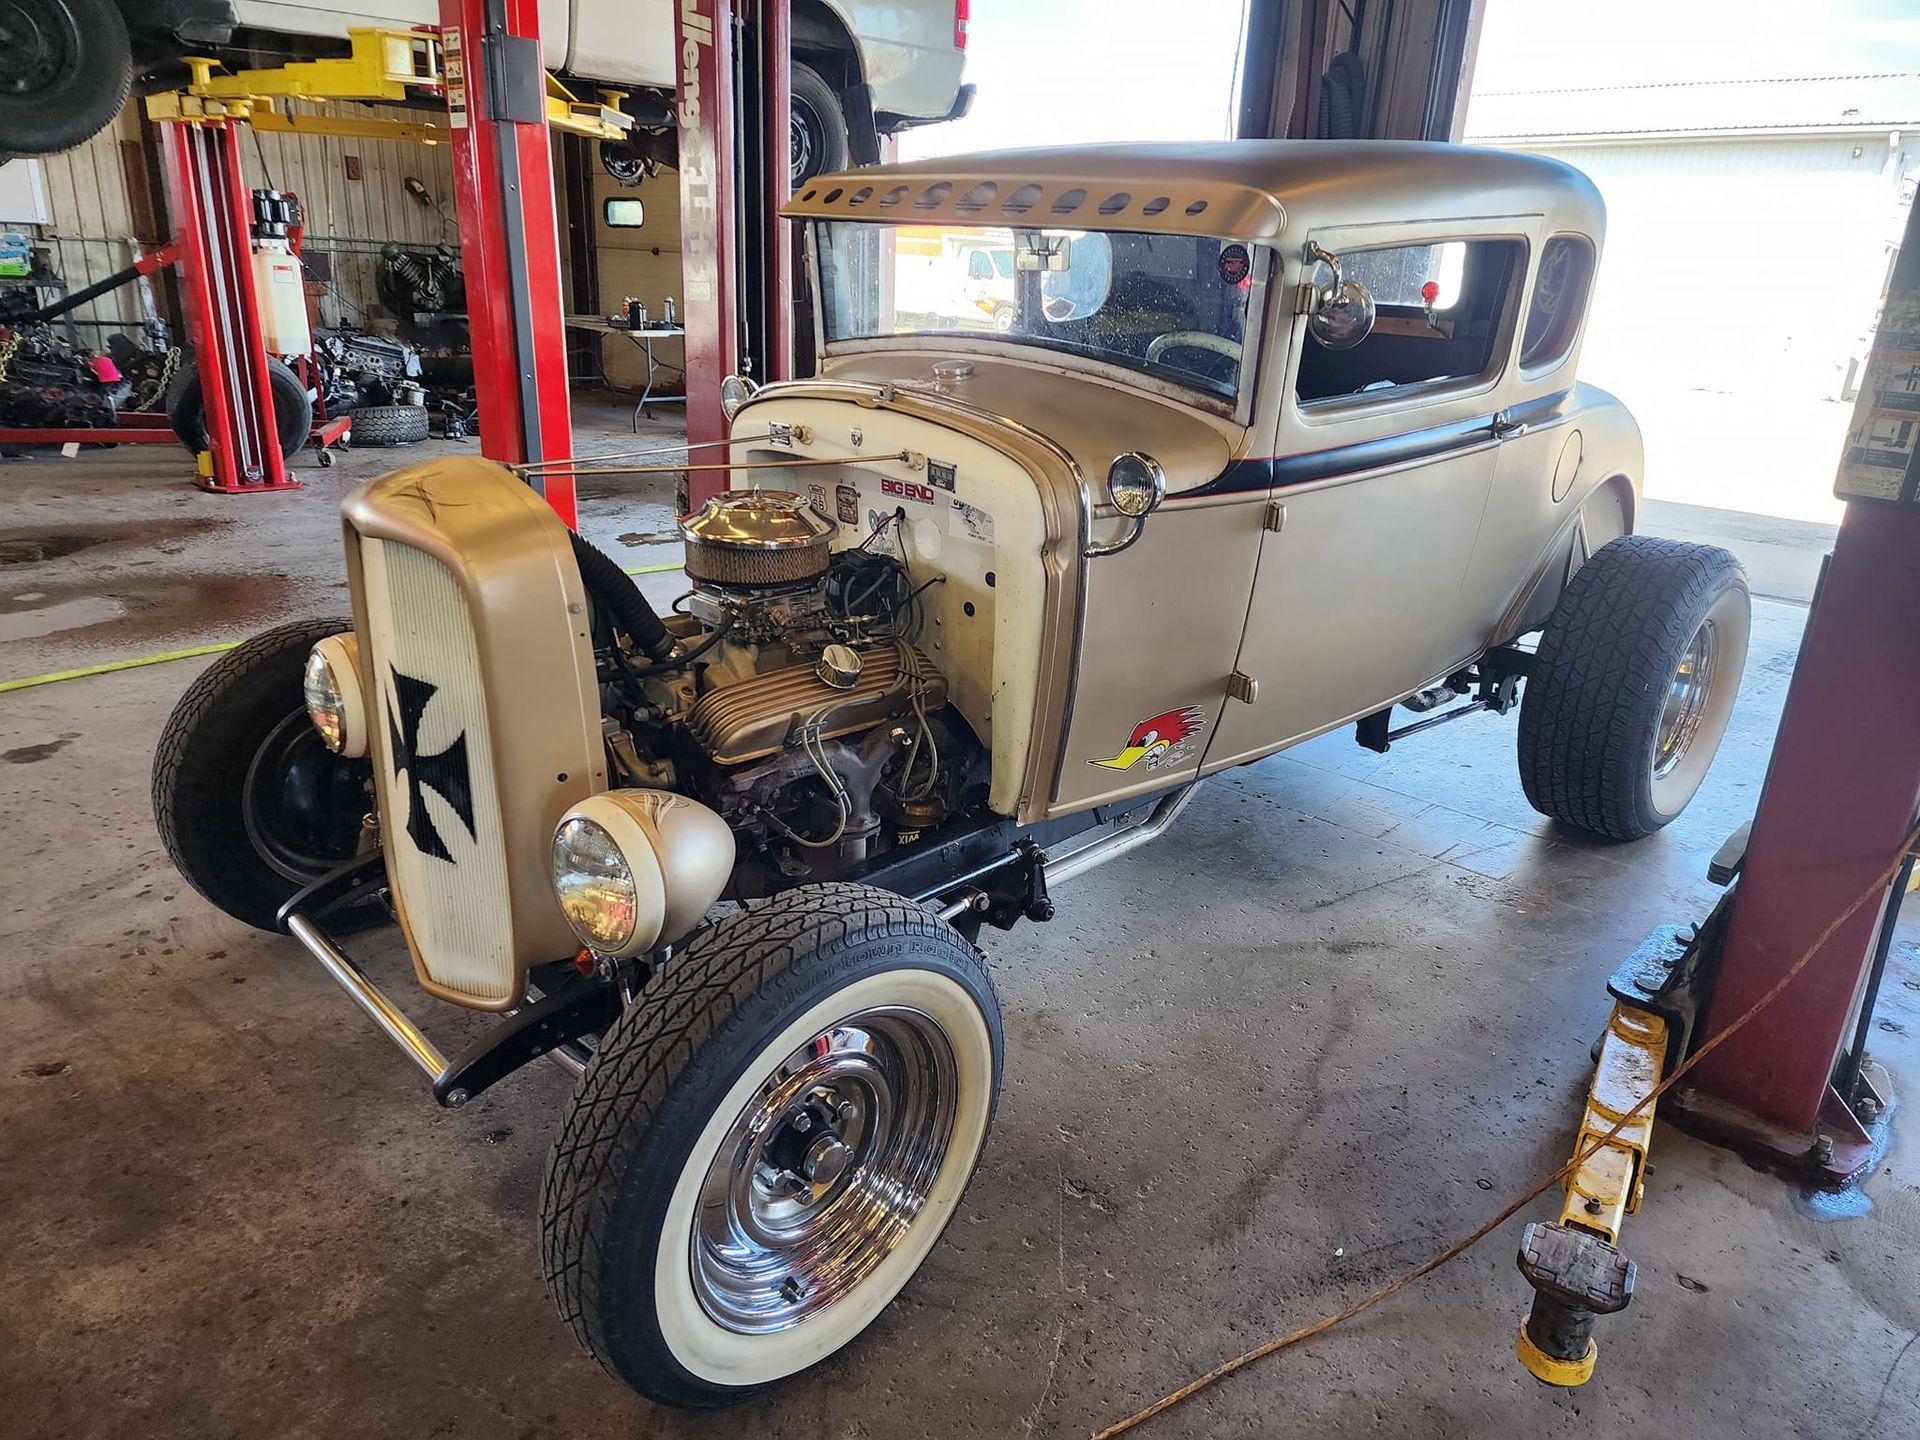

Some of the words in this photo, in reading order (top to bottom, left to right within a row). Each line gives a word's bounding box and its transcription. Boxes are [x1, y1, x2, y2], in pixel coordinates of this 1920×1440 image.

[881, 479, 903, 494] BIG
[904, 483, 934, 501] END
[908, 938, 970, 972] Radial
